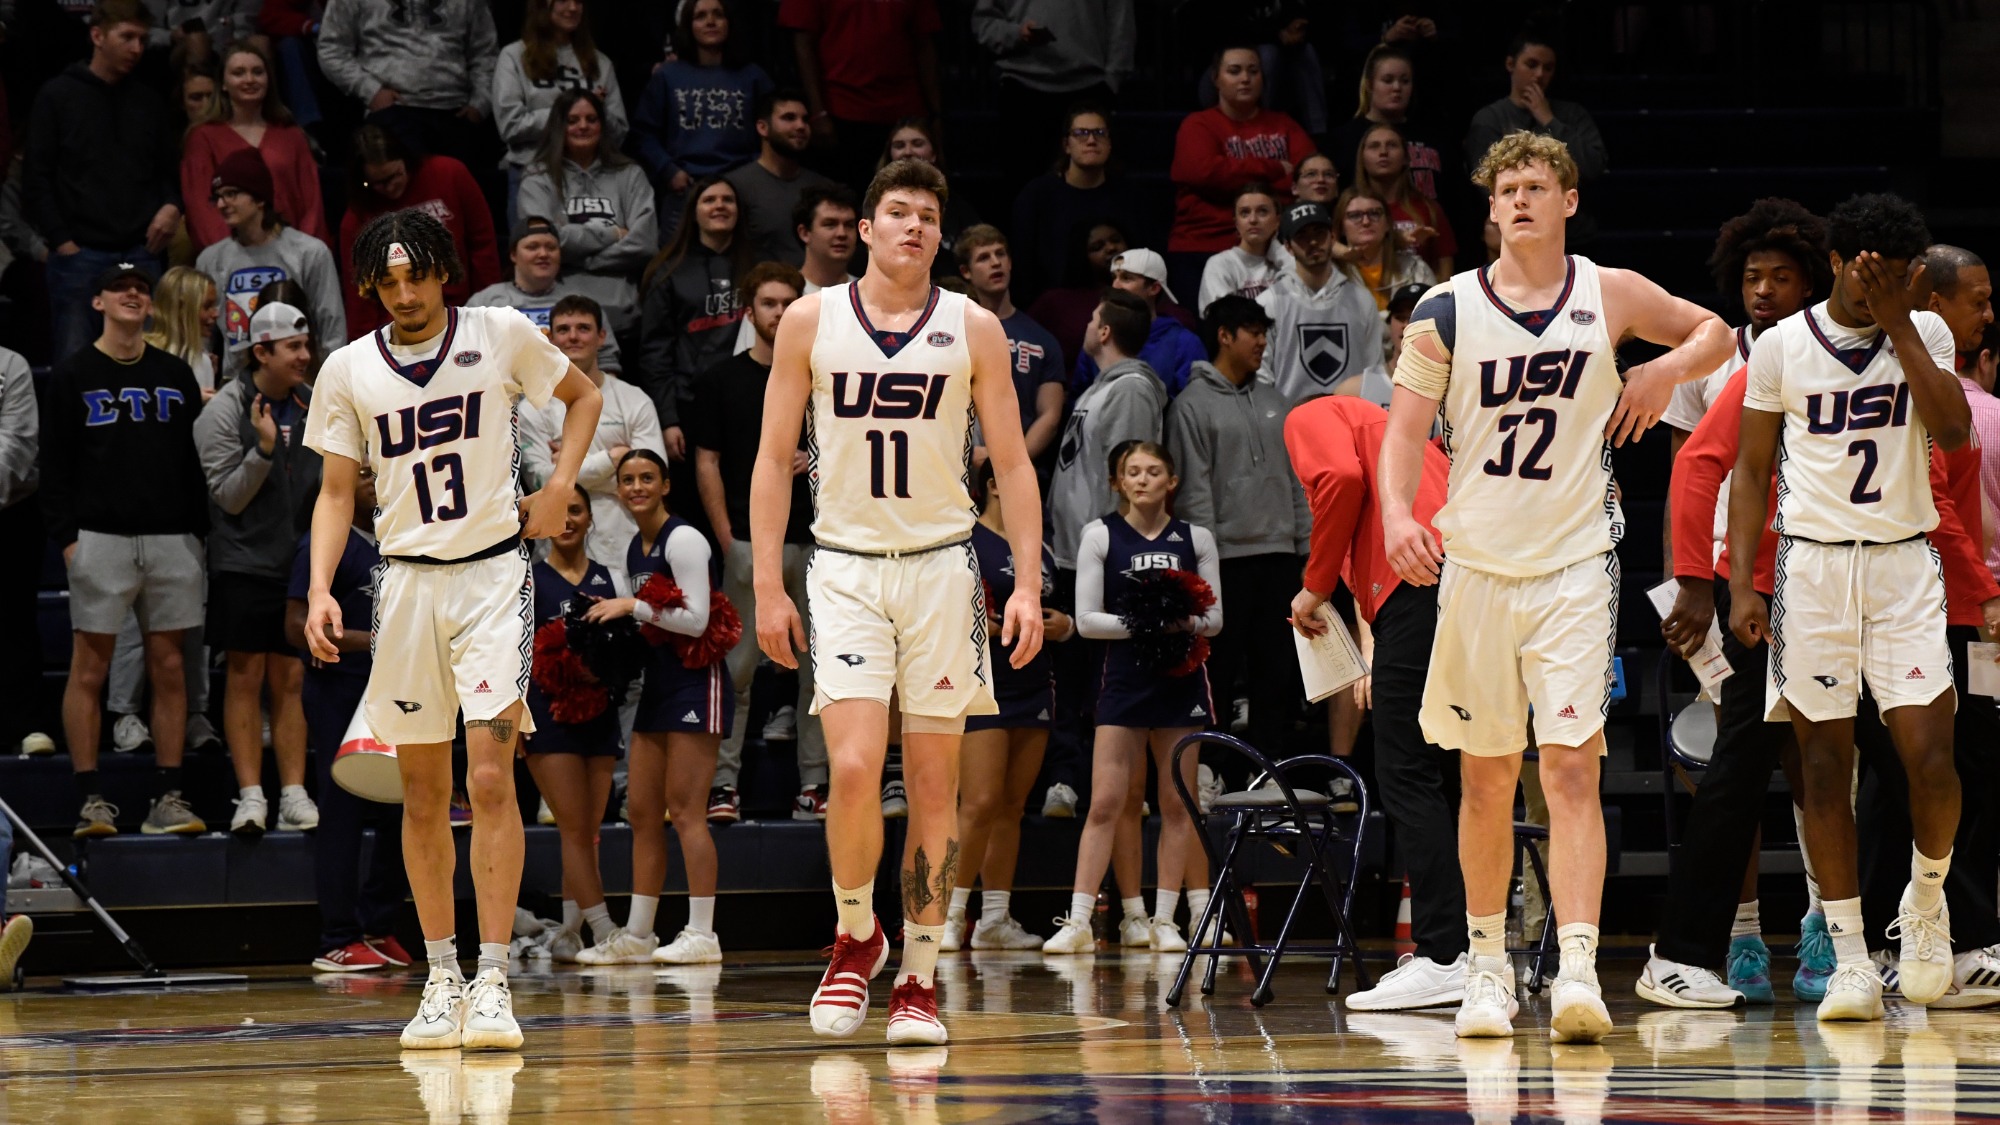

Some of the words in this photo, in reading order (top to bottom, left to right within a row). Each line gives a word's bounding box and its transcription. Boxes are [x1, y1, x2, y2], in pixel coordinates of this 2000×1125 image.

[674, 88, 746, 130] USI
[567, 197, 614, 216] USI
[234, 272, 278, 289] USI
[830, 372, 951, 419] USI
[1478, 348, 1593, 408] USI
[373, 390, 486, 459] USI
[1805, 382, 1910, 434] USI
[865, 429, 913, 499] 11
[1483, 407, 1557, 481] 32
[412, 452, 468, 524] 13
[1848, 438, 1882, 504] 2
[1134, 553, 1180, 572] USI
[1557, 711, 1578, 720] adidas
